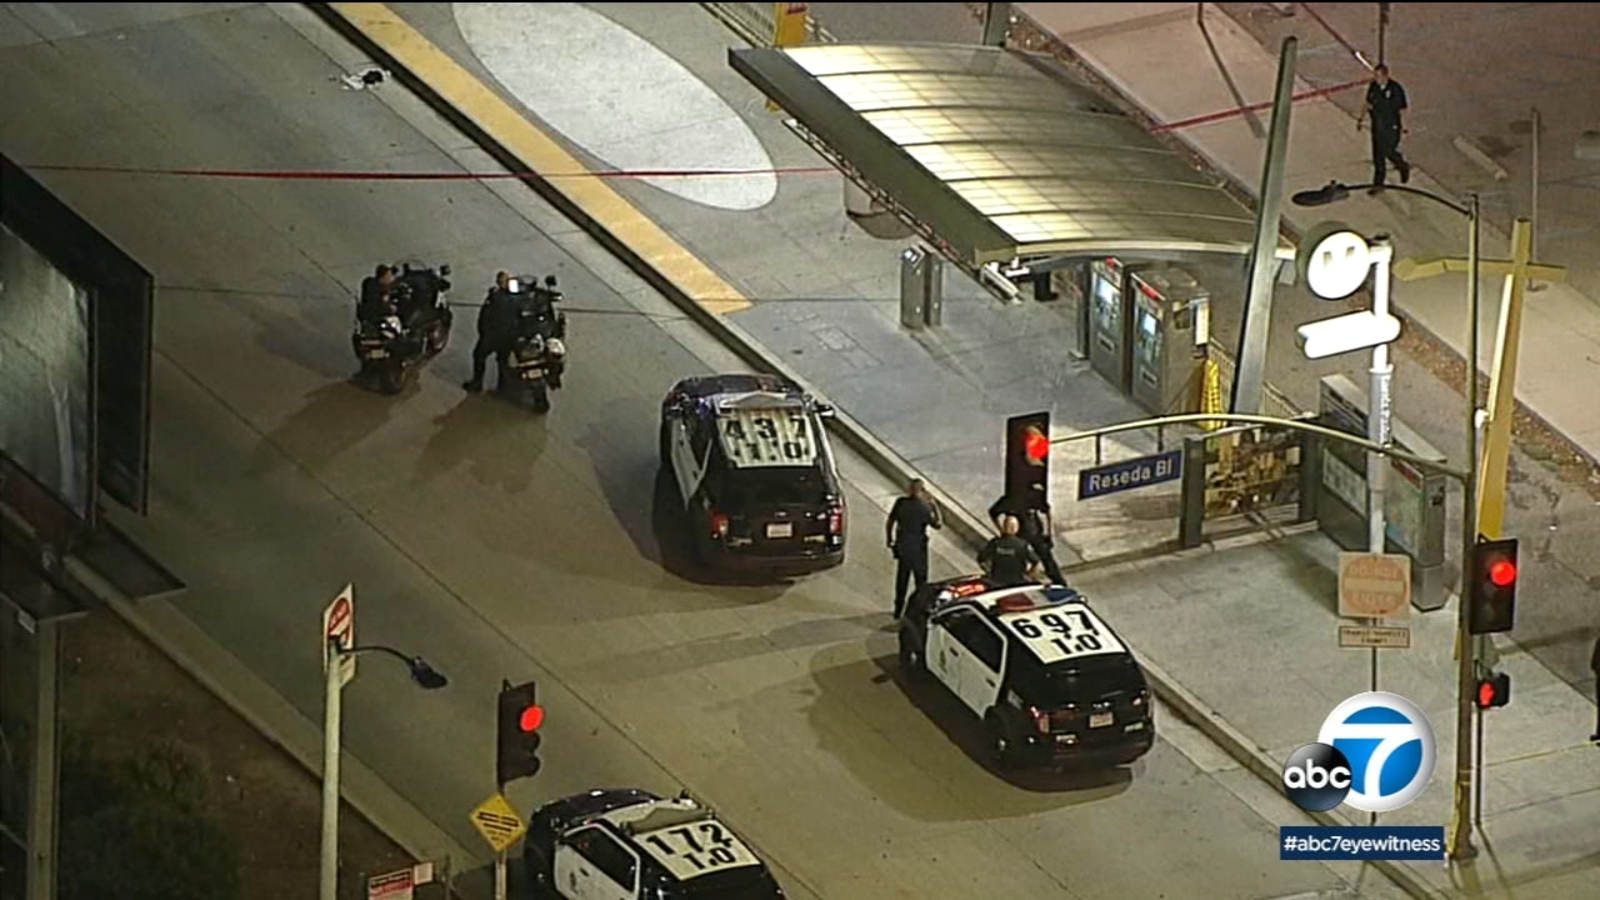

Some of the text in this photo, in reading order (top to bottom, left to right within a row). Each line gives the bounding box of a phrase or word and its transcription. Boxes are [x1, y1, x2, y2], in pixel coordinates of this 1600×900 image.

[726, 417, 808, 448] 437
[1089, 458, 1173, 491] Reseda Bl
[1011, 610, 1099, 640] 697
[1051, 634, 1102, 655] 1.0
[646, 824, 733, 855] 172
[683, 847, 736, 870] 1.0
